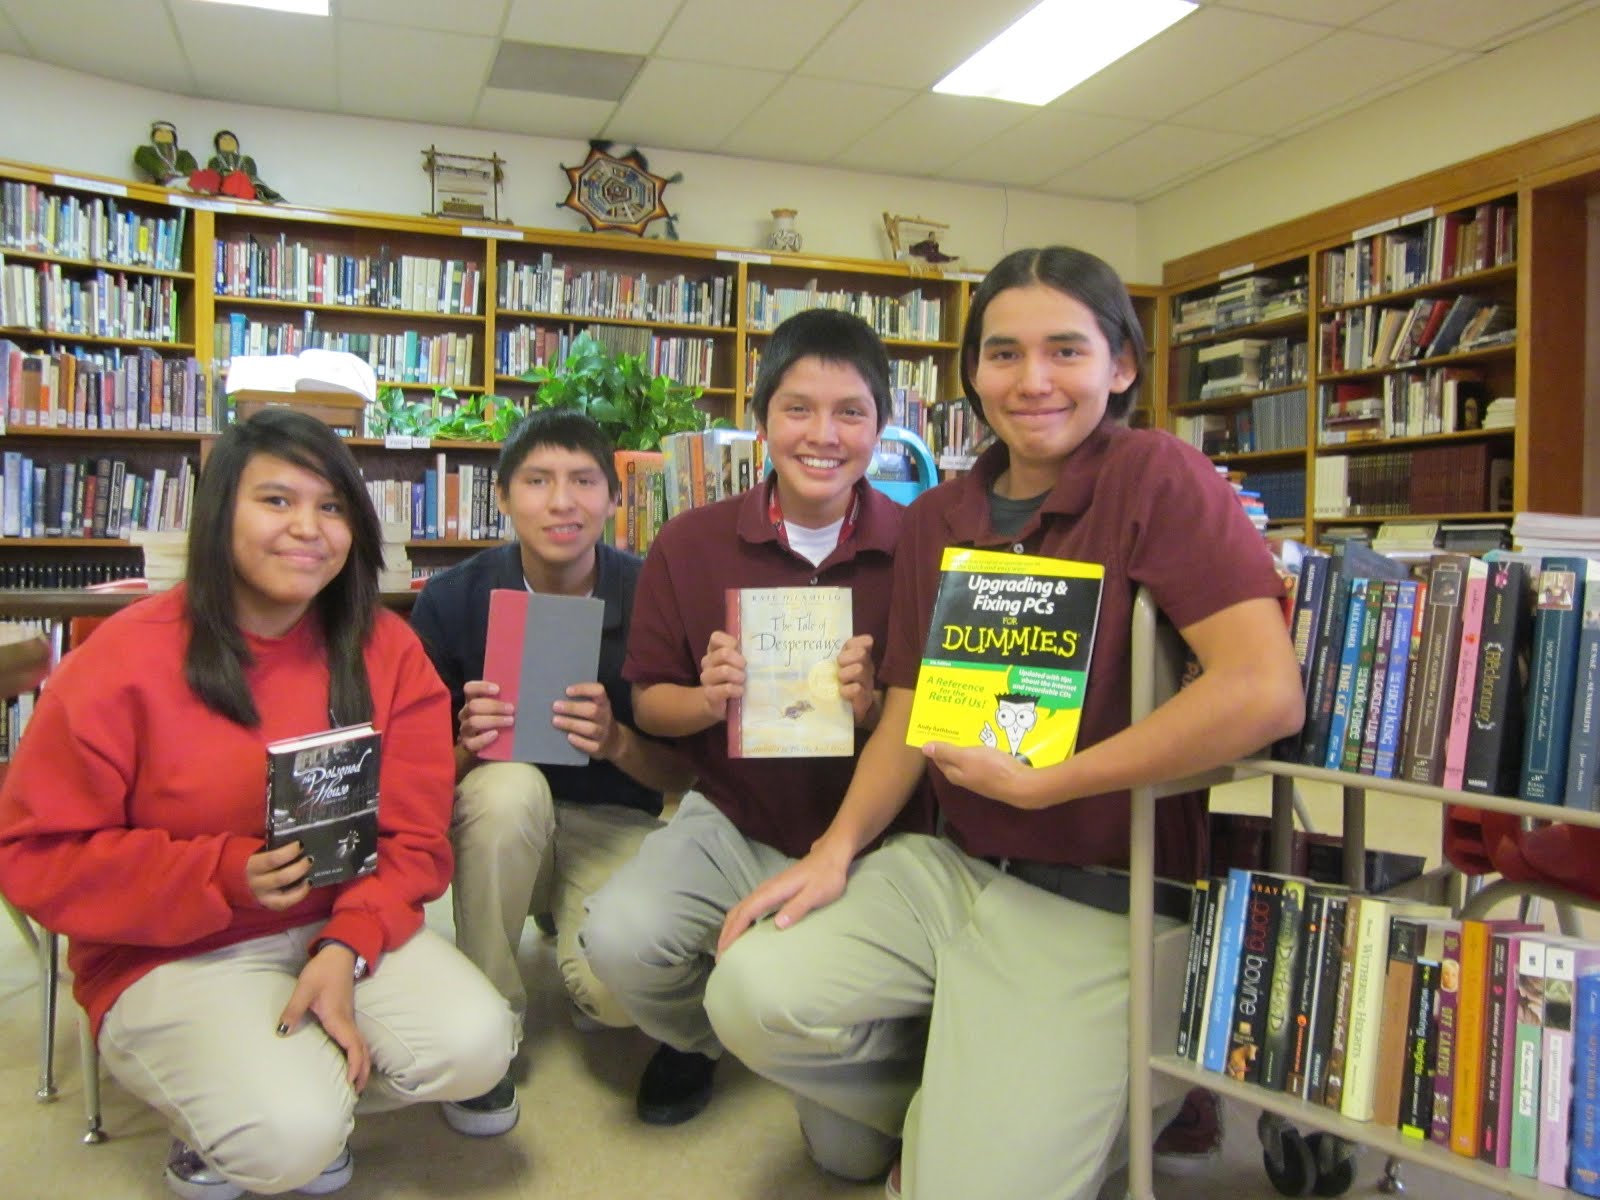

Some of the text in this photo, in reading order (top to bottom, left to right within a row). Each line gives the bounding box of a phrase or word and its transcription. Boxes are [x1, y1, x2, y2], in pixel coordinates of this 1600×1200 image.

[968, 575, 1068, 597] Upgrading &
[973, 594, 1055, 616] Fixing PCs
[1002, 617, 1018, 625] FOR
[770, 612, 826, 637] The Tale of
[752, 633, 841, 667] Despereaux
[942, 625, 1077, 658] DUMMIES
[1018, 669, 1045, 680] Updated
[1046, 672, 1061, 681] with
[1334, 602, 1363, 718] ALEXANDER TIME CAT
[927, 675, 985, 693] A Reference
[929, 692, 953, 704] Rest
[955, 695, 967, 706] of
[1383, 683, 1399, 713] HIGH
[1380, 714, 1399, 745] KING
[293, 748, 372, 795] Poisoned
[311, 783, 350, 807] House
[1239, 900, 1270, 1016] going bovine
[1357, 944, 1373, 1009] WUTHERING
[1416, 988, 1430, 1036] wuthering
[1352, 1011, 1368, 1058] HEIGHTS
[1437, 1006, 1453, 1077] OFF CAMPUS
[1413, 1038, 1426, 1075] heights
